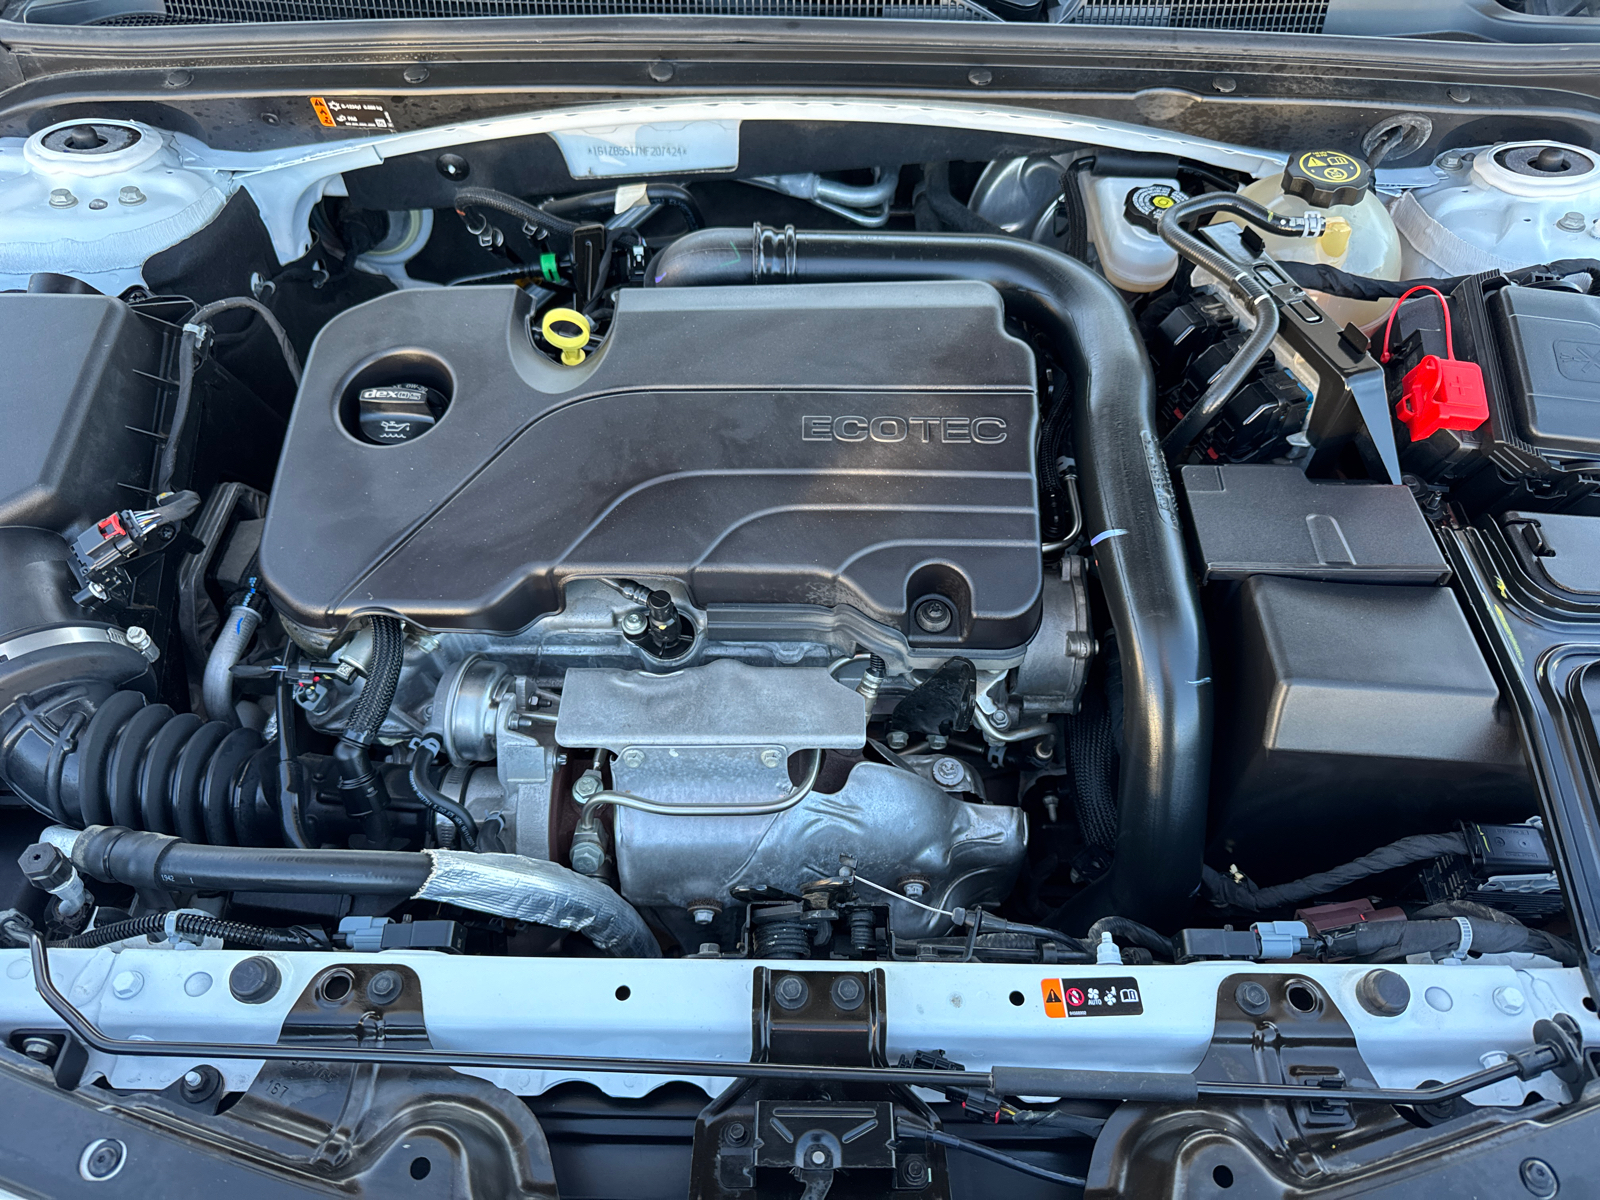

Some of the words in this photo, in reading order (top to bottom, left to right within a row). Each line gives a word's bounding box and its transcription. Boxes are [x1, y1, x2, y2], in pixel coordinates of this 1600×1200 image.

[363, 389, 421, 400] dexos
[802, 415, 1008, 444] ECOTEC
[1087, 998, 1103, 1006] AUTO
